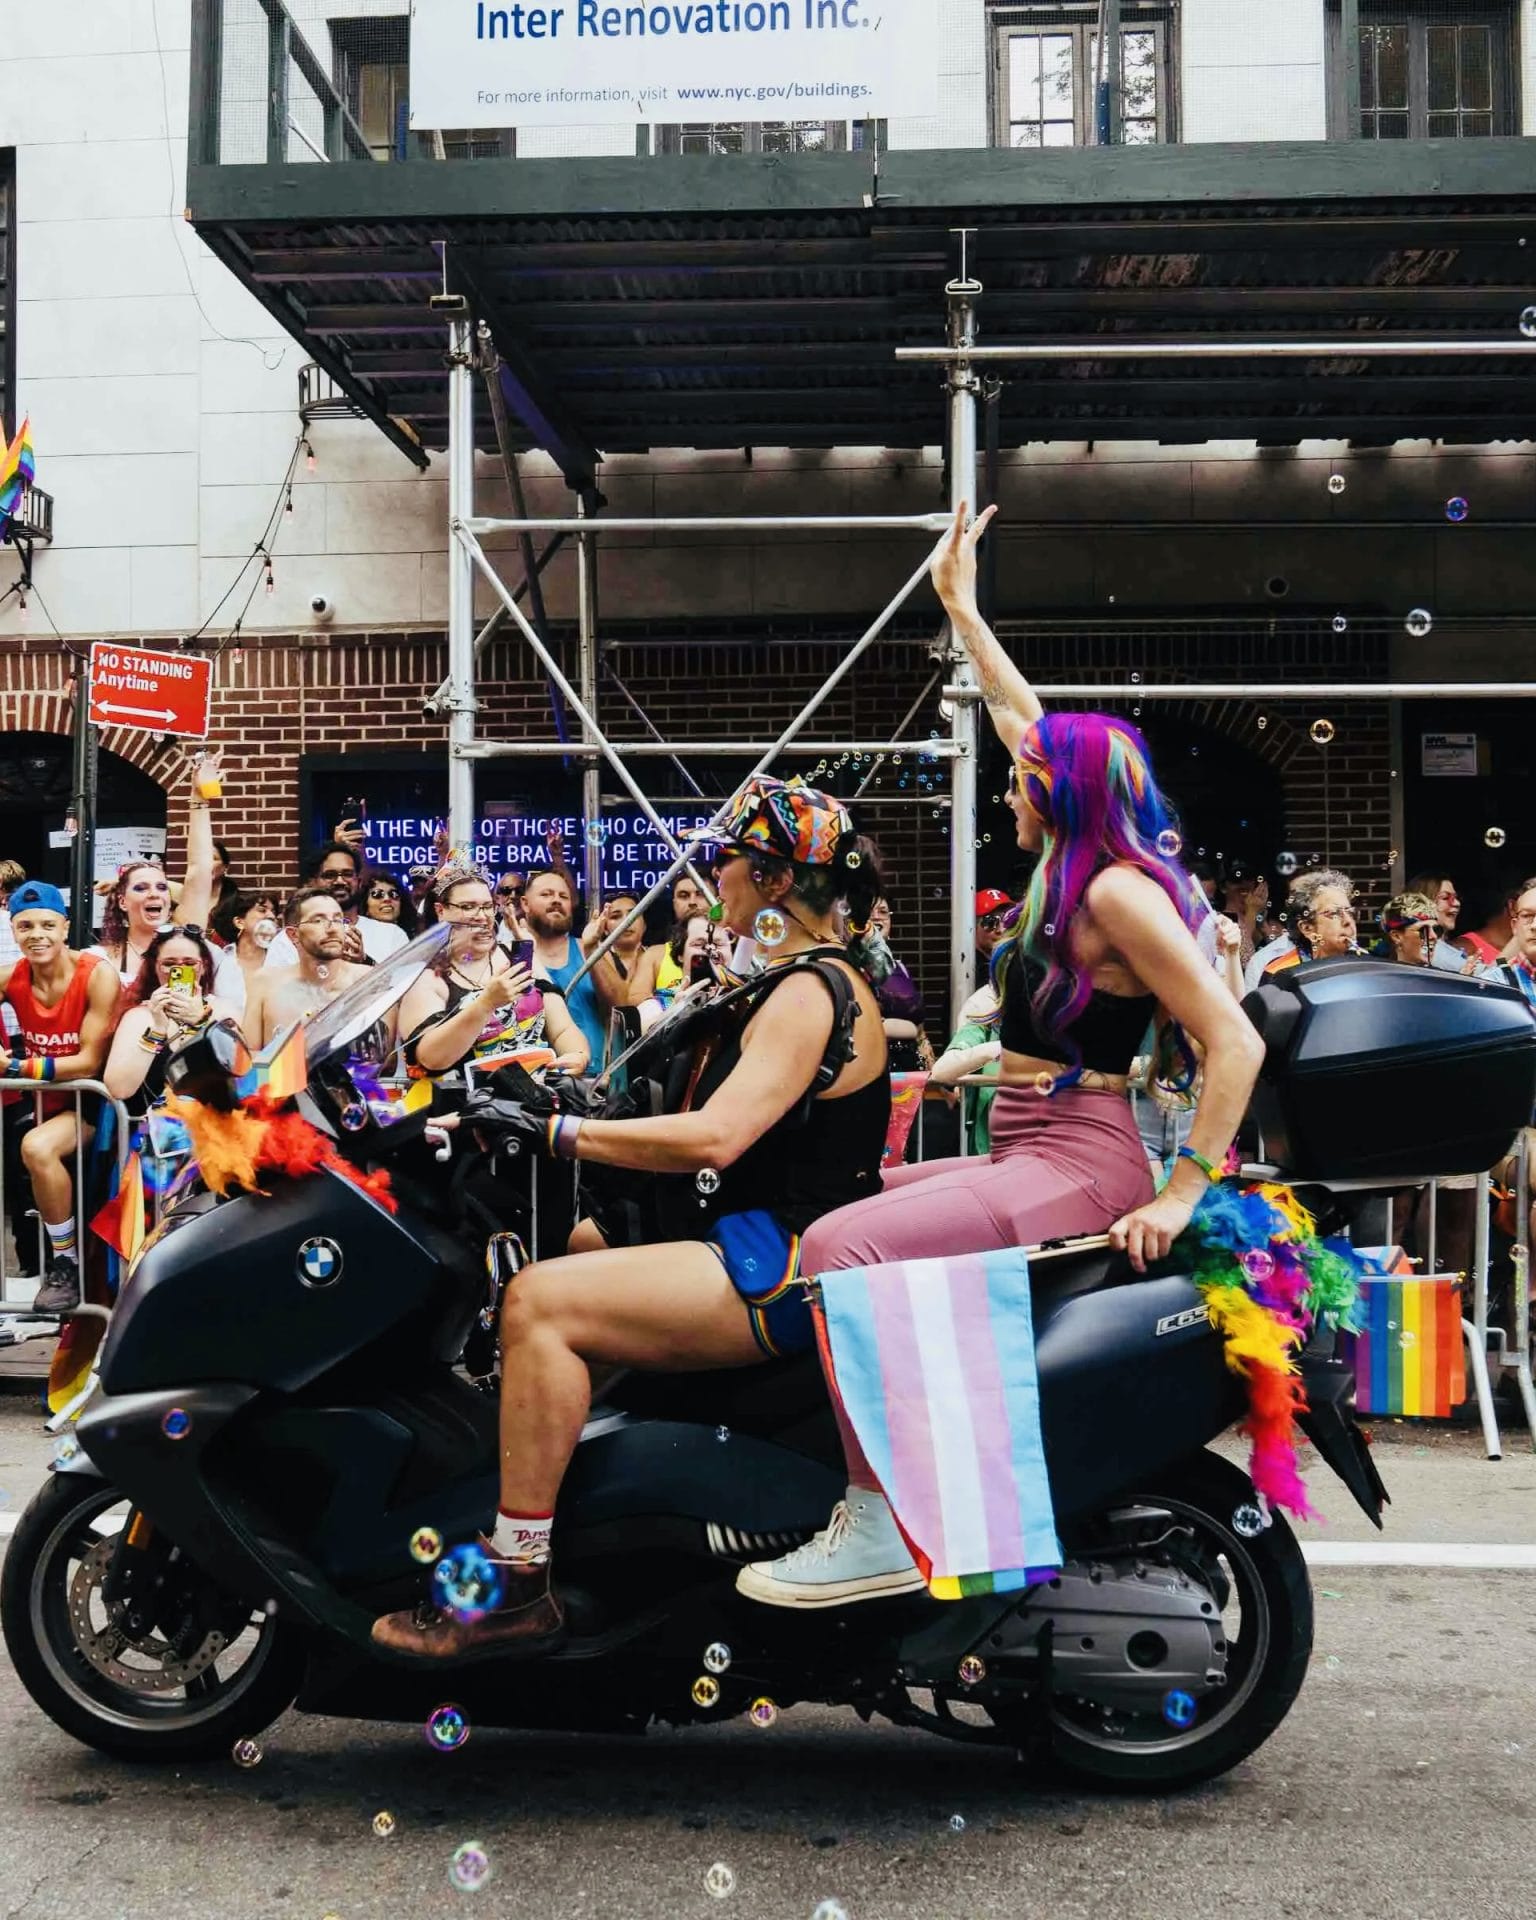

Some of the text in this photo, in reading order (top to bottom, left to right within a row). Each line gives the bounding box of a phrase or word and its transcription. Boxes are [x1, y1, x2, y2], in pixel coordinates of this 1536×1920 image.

[477, 0, 870, 39] Inter Renovation Inc.
[477, 82, 872, 104] For more information, visit www.nyc.gov/buildings.
[98, 652, 193, 680] NO STANDING
[97, 670, 158, 692] Anytime
[376, 819, 416, 838] THE
[481, 818, 507, 837] OF
[511, 817, 577, 837] THOSE
[581, 816, 627, 836] HO
[365, 846, 439, 864] PLEDGE
[475, 845, 500, 863] BE
[613, 844, 639, 861] BE
